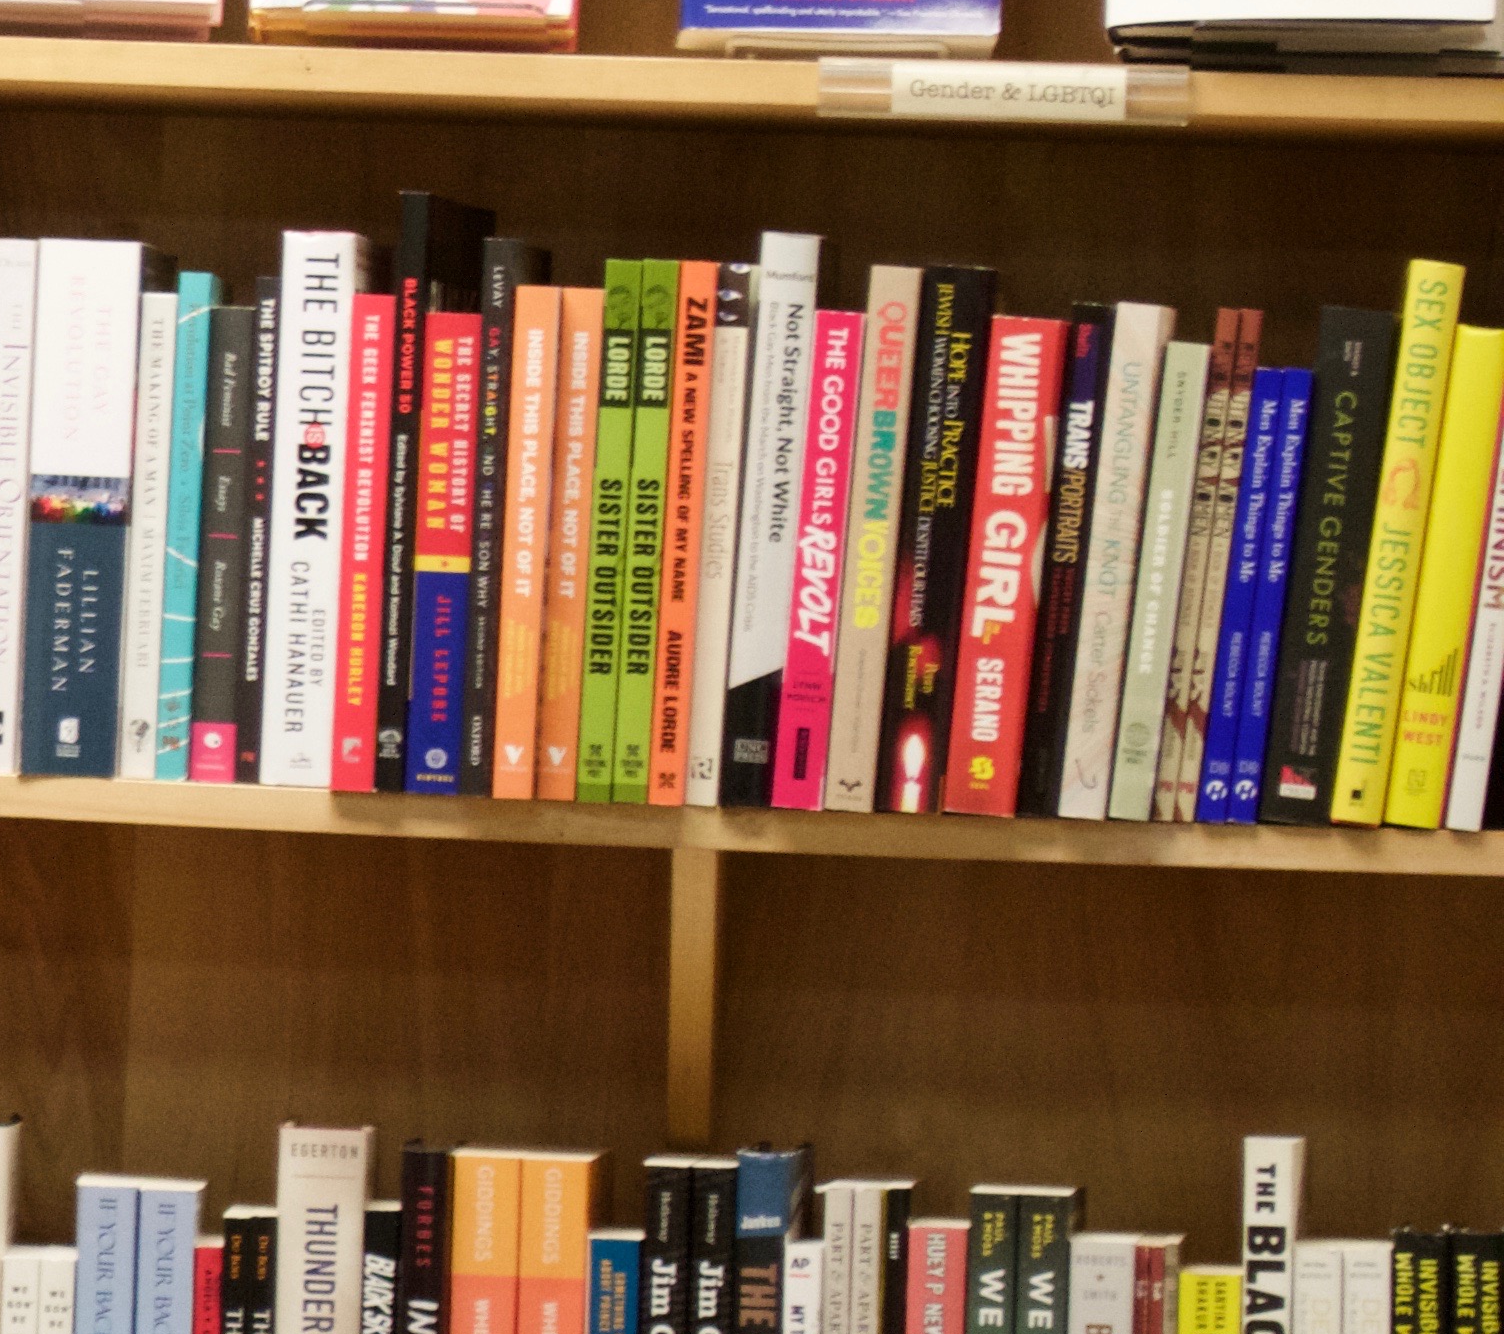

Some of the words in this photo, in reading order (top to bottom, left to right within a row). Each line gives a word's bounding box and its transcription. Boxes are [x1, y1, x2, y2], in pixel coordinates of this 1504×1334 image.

[908, 77, 994, 103] Gender
[1001, 80, 1020, 103] &
[1027, 82, 1116, 110] LGBTQI
[991, 331, 1040, 498] WHIPPING
[597, 478, 624, 560] SISTER
[980, 510, 1028, 637] GIRL
[585, 569, 619, 677] OUTSIDER
[972, 657, 1001, 743] SERANO
[1254, 1164, 1277, 1217] THE
[978, 1268, 1005, 1329] WE
